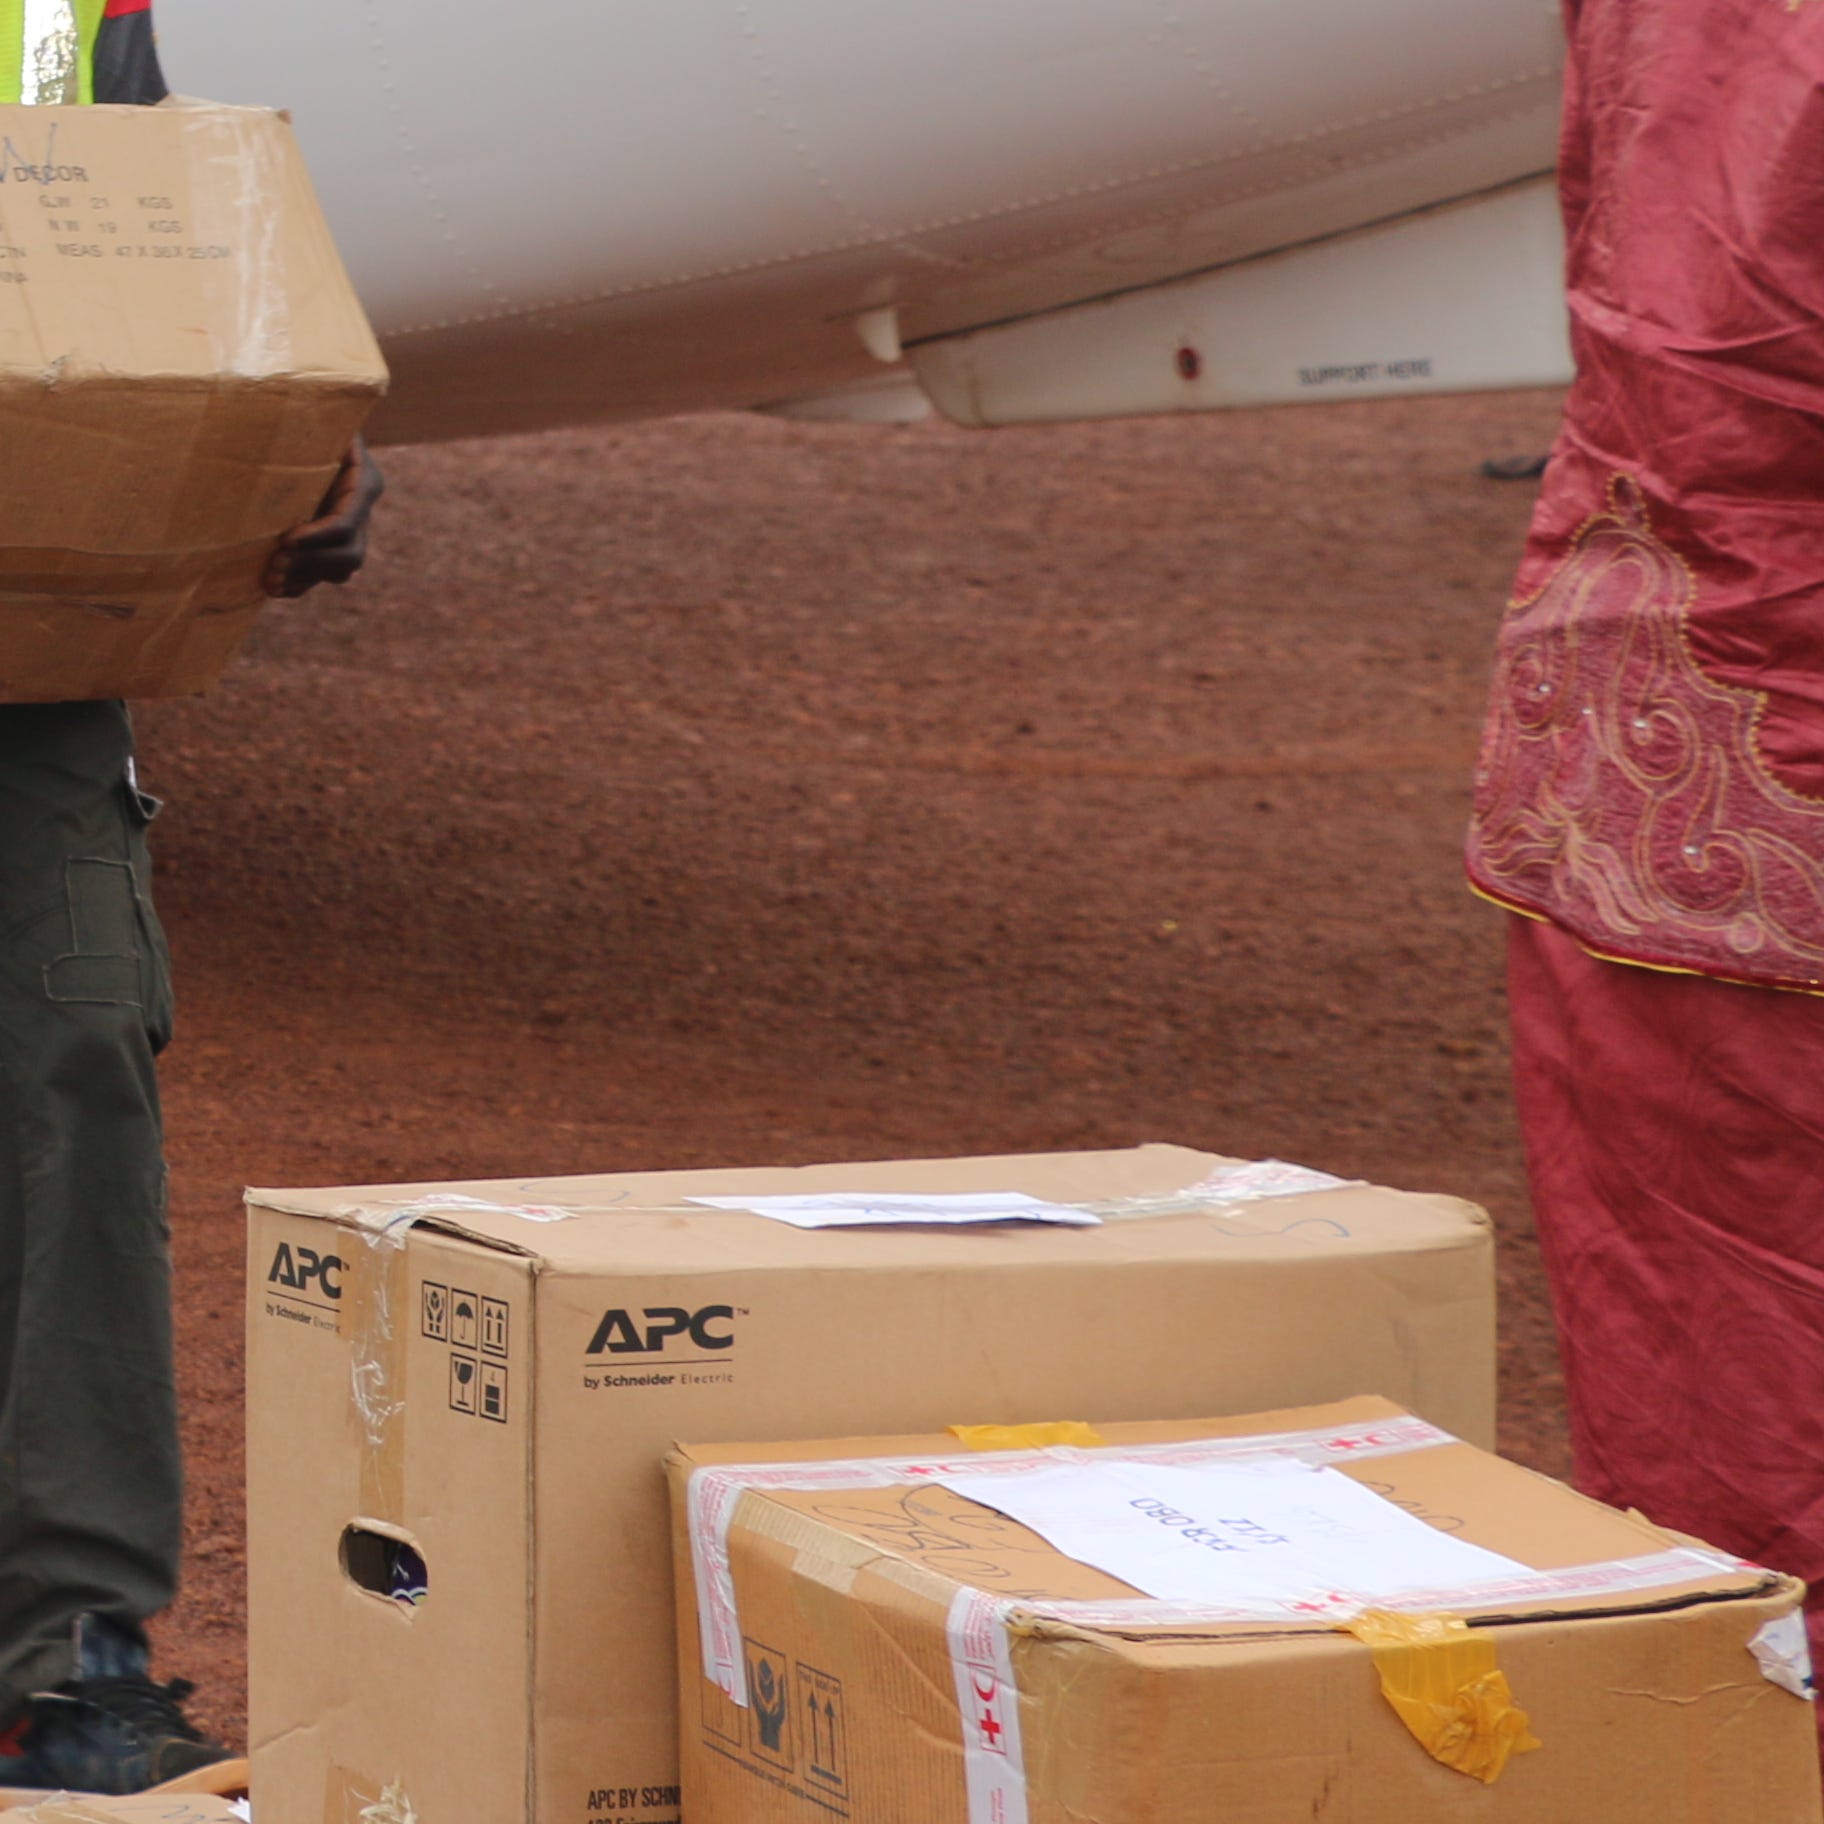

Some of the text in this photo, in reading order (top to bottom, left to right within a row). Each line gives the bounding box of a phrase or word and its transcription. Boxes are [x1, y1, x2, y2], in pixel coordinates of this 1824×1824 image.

[12, 164, 89, 183] DECOR
[268, 1241, 342, 1299] APC
[585, 1305, 734, 1354] APC
[584, 1376, 600, 1390] by
[604, 1374, 675, 1388] Schneider
[587, 1789, 616, 1811] APC
[618, 1787, 638, 1809] BY
